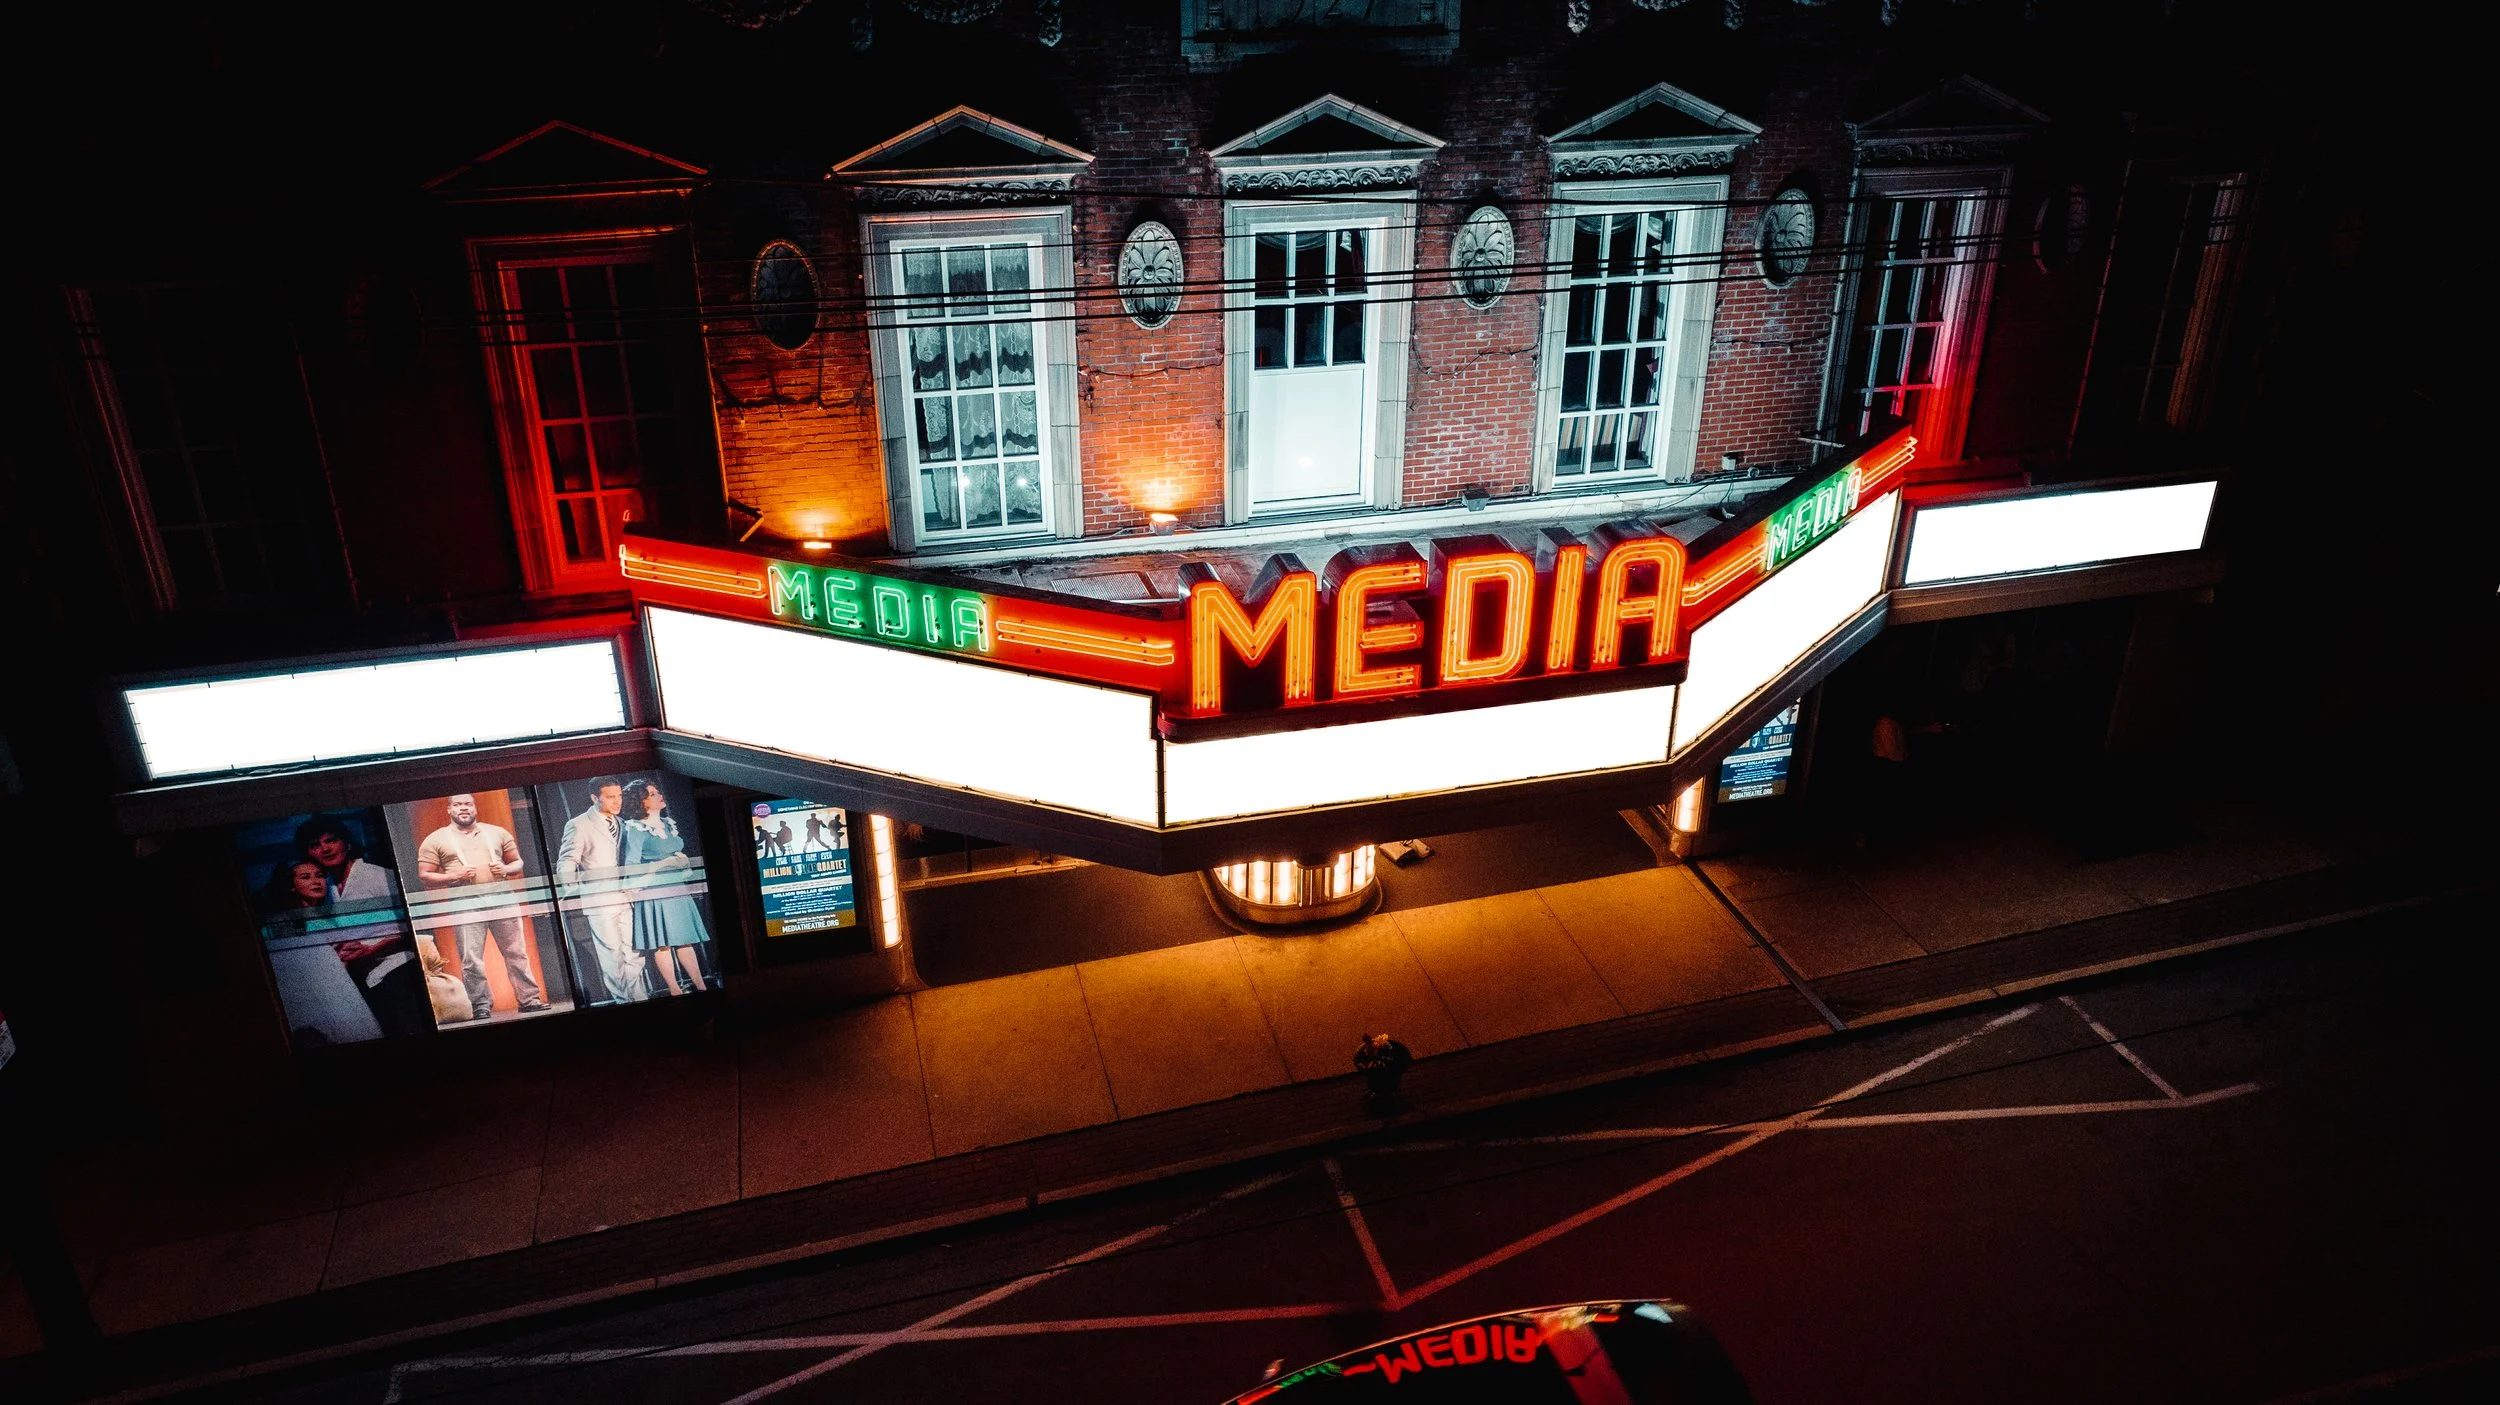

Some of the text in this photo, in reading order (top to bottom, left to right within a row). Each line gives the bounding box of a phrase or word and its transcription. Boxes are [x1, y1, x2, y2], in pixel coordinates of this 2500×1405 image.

[1766, 468, 1862, 570] MEDIA
[768, 565, 989, 652] MEDIA
[1189, 535, 1687, 717] MEDIA
[763, 866, 792, 878] MILLION
[817, 859, 847, 872] QUARTET
[782, 919, 840, 933] MEDIATHEATRE.ORG
